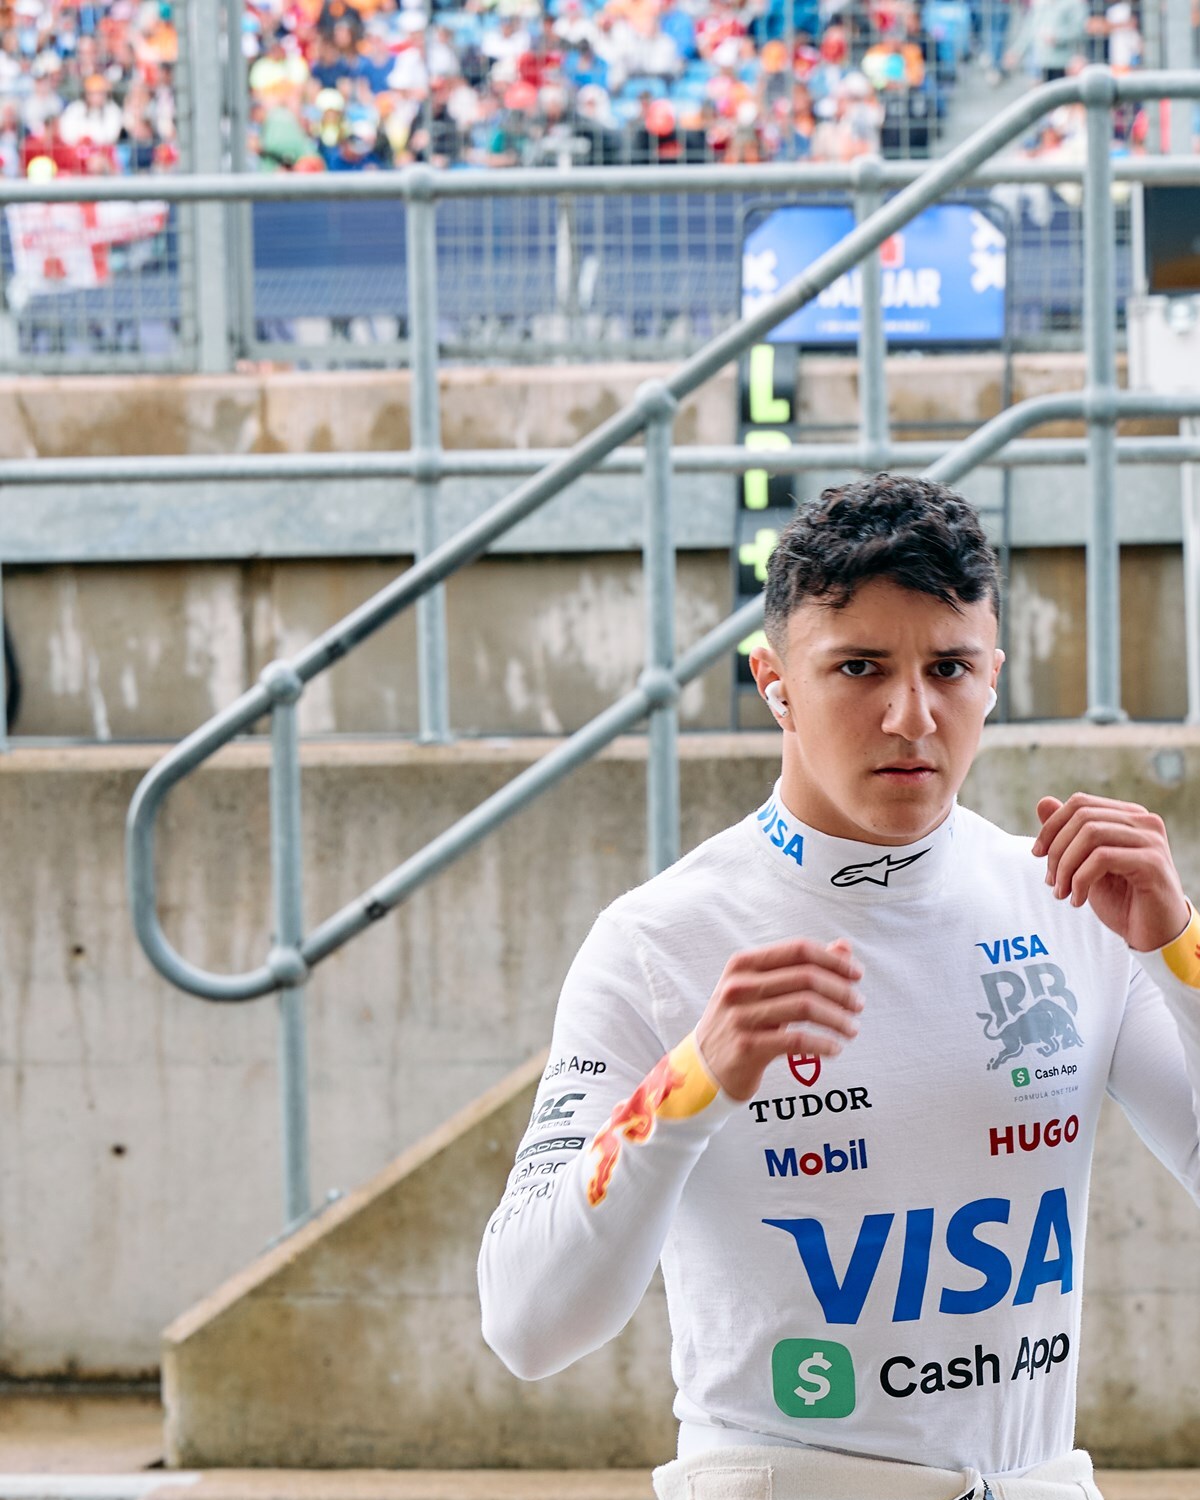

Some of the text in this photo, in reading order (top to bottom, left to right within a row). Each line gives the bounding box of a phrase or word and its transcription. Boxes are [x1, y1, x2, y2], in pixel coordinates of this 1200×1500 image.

[975, 934, 1049, 965] VISA
[568, 1056, 606, 1075] App
[1034, 1066, 1059, 1080] Cash
[1061, 1064, 1078, 1077] App
[749, 1086, 872, 1123] TUDOR
[1014, 1085, 1079, 1103] FORMULA ONE TEAM
[989, 1114, 1079, 1156] HUGO
[764, 1138, 868, 1177] Mobil
[762, 1187, 1073, 1325] VISA
[880, 1345, 1000, 1398] Cash
[1011, 1332, 1070, 1381] App
